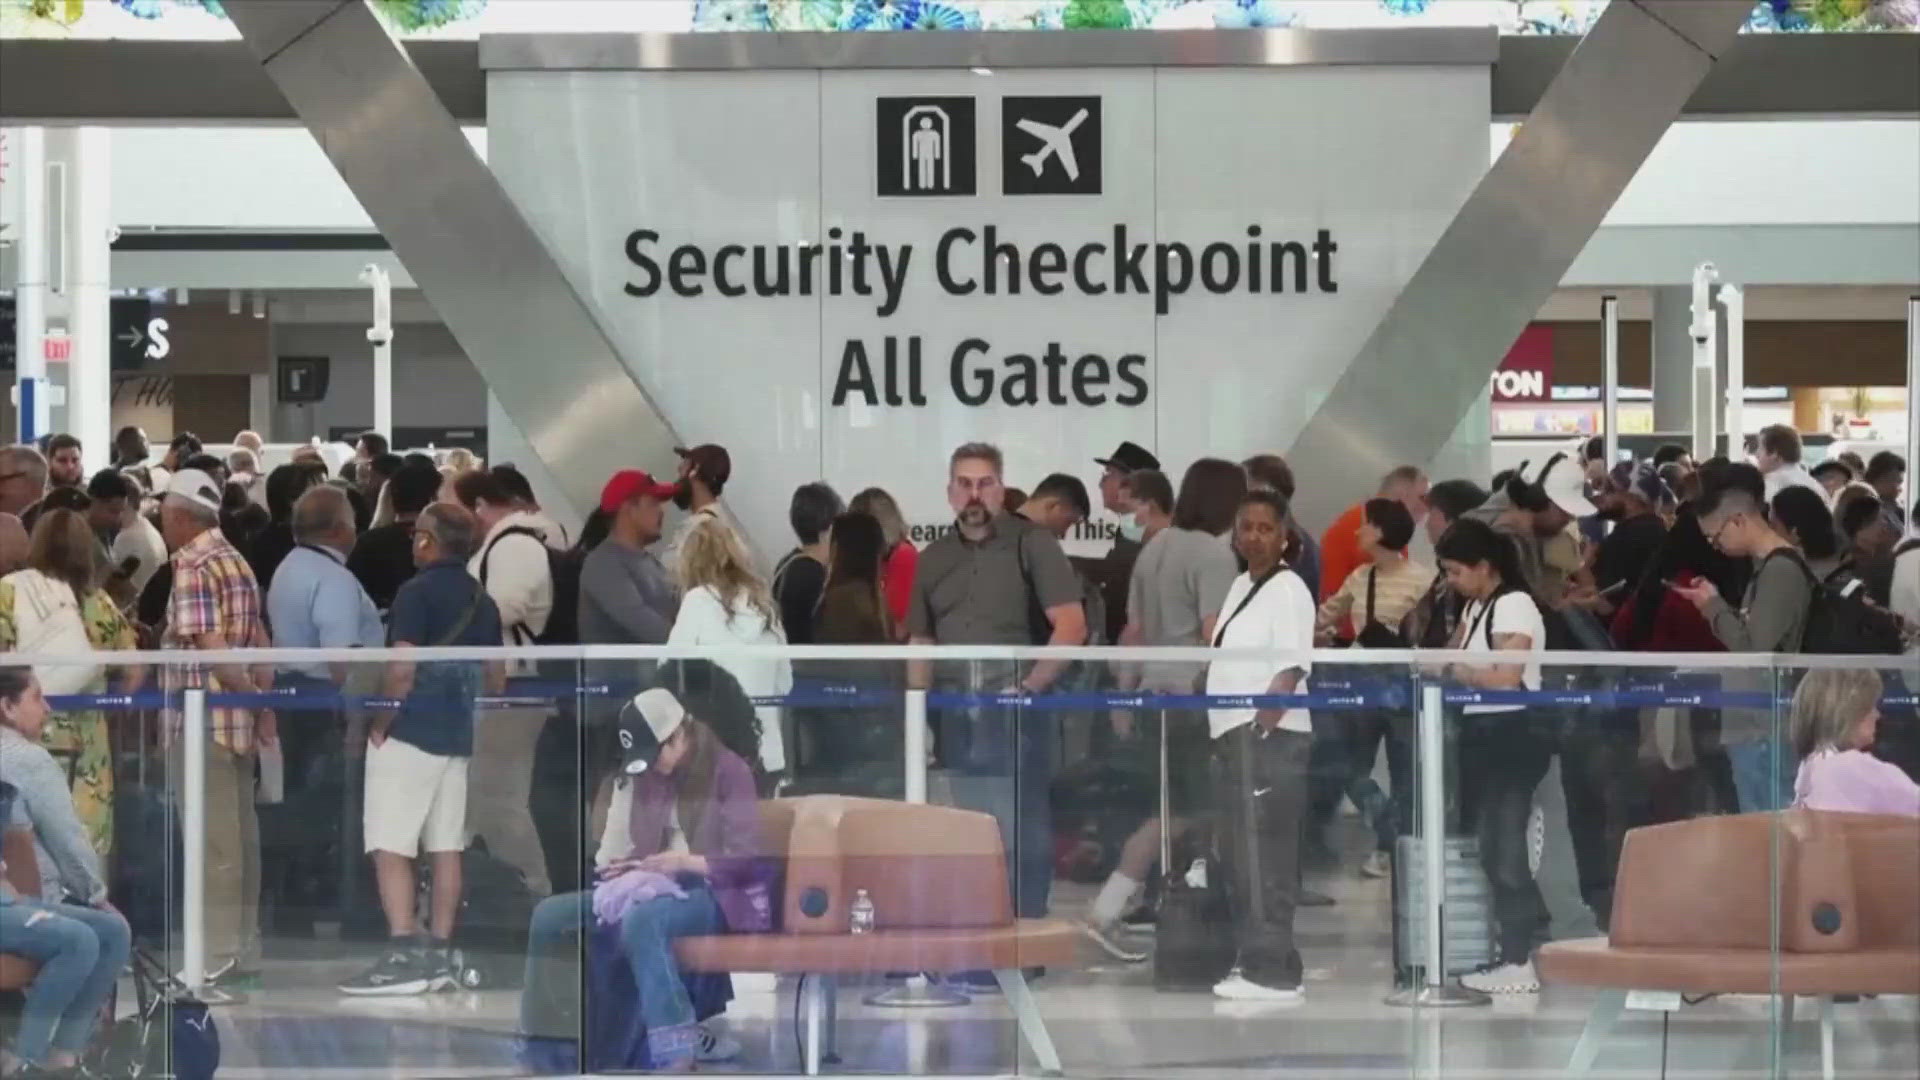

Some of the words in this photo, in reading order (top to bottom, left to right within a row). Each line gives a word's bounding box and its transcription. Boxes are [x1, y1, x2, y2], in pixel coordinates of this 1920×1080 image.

[624, 227, 913, 317] Security
[936, 224, 1338, 315] Checkpoint
[832, 336, 927, 407] All
[950, 337, 1149, 407] Gates
